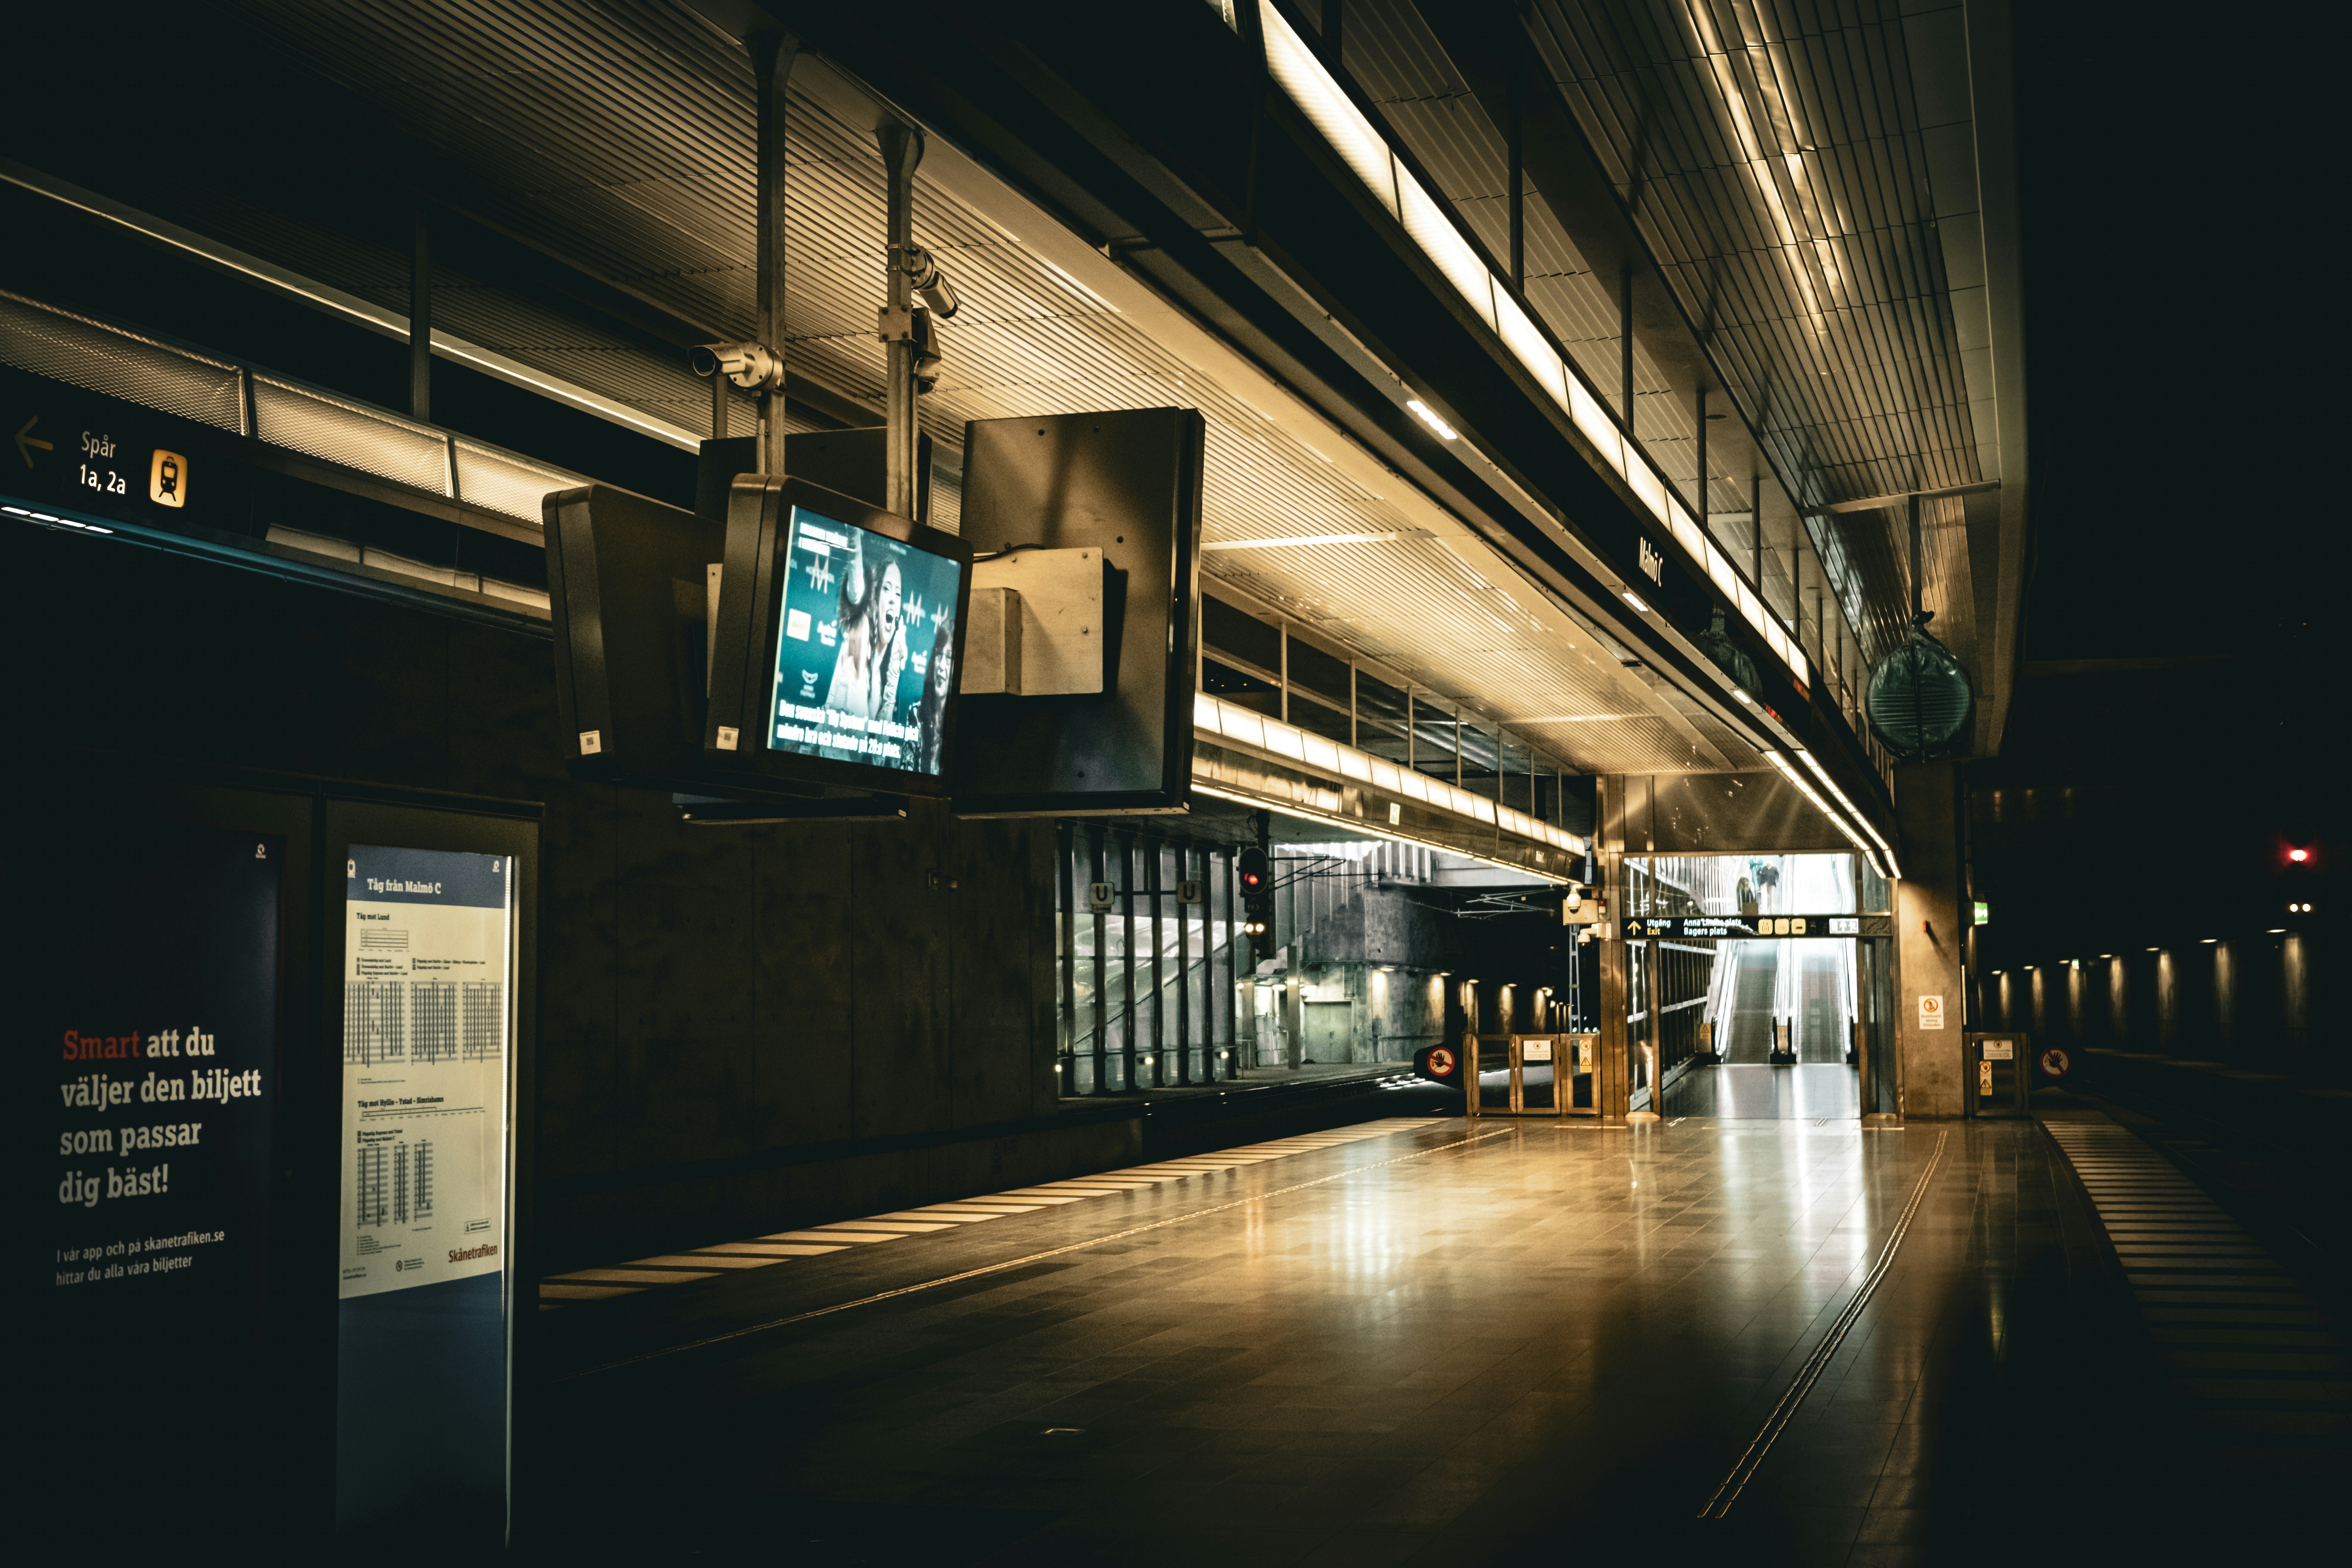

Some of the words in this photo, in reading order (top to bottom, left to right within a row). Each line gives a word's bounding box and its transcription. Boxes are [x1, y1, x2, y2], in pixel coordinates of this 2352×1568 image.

[81, 431, 116, 458] Spår
[80, 464, 101, 491] 1a,
[107, 472, 126, 494] 2a
[1639, 537, 1658, 582] Malmö
[1658, 557, 1663, 587] C
[804, 727, 818, 744] bra
[818, 730, 832, 746] och
[367, 879, 384, 893] Tåg
[386, 879, 403, 891] från
[406, 881, 433, 893] Malmö
[435, 883, 441, 894] C
[1096, 886, 1107, 901] U
[1184, 884, 1195, 900] U
[1647, 919, 1671, 928] Utgång
[1684, 927, 1707, 937] Bagers
[1709, 926, 1727, 937] plats
[1725, 918, 1741, 928] plats
[63, 1029, 140, 1060] Smart
[147, 1029, 179, 1057] att
[186, 1026, 214, 1056] du
[61, 1074, 134, 1112] väljer
[141, 1072, 185, 1102] den
[191, 1069, 261, 1104] biljett
[60, 1129, 112, 1155] som
[120, 1123, 201, 1156] passar
[59, 1170, 100, 1207] dig
[107, 1164, 168, 1198] bäst!
[64, 1246, 79, 1262] vår
[83, 1247, 102, 1261] app
[106, 1241, 124, 1256] och
[129, 1238, 141, 1256] på
[144, 1231, 224, 1251] skanetrafiken.se
[449, 1244, 498, 1263] Skånetrafiken
[57, 1271, 84, 1286] hittar
[88, 1267, 100, 1281] du
[105, 1264, 123, 1279] alla
[127, 1260, 149, 1275] våra
[153, 1256, 192, 1273] biljetter
